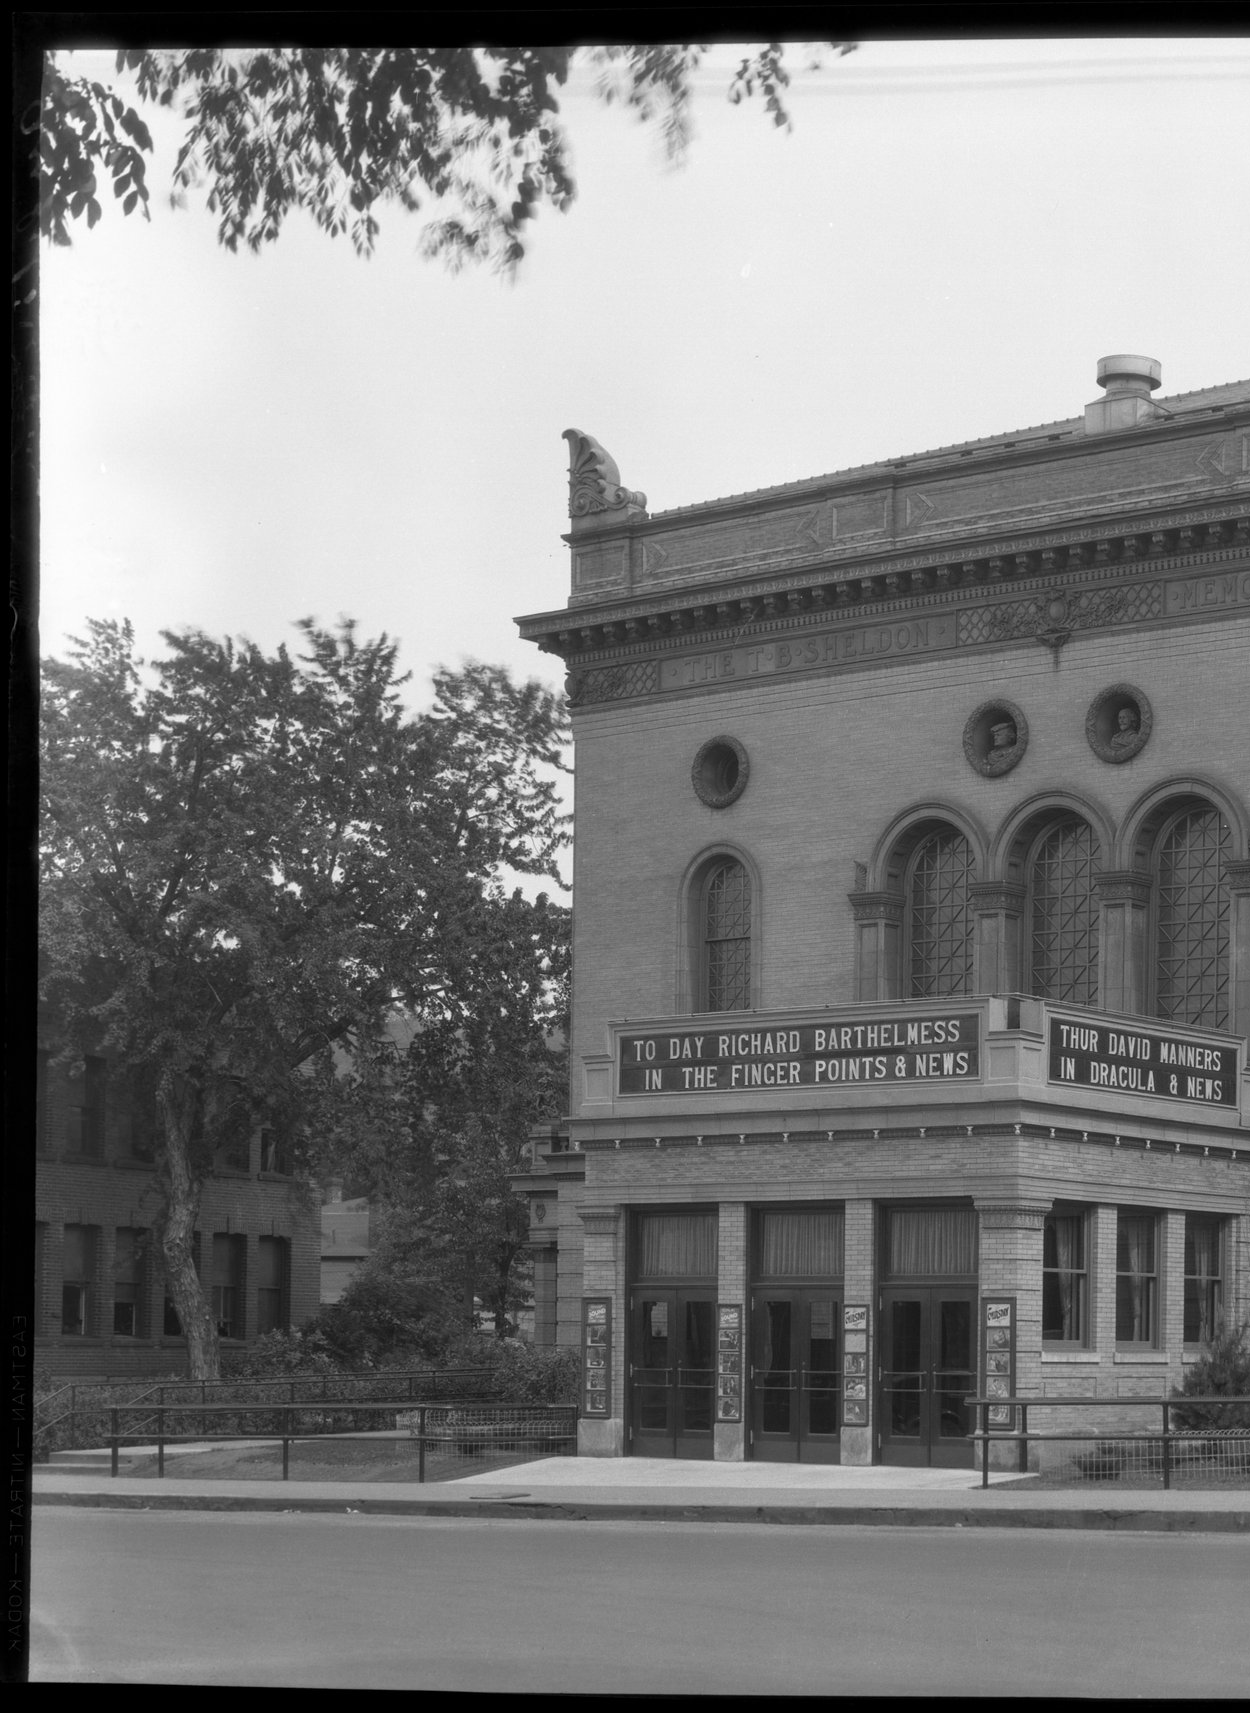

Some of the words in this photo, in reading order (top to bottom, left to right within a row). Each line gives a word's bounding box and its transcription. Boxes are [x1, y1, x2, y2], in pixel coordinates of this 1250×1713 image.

[684, 652, 736, 683] THE
[803, 620, 931, 665] SHELDON
[633, 1040, 656, 1062] TO
[669, 1036, 704, 1060] DAY
[718, 1030, 800, 1057] RICHARD
[815, 1020, 960, 1051] BARTHELMESS
[1060, 1024, 1098, 1053] THUR
[1109, 1032, 1151, 1060] DAVID
[1159, 1042, 1221, 1072] MANNERS
[645, 1068, 662, 1090] IN
[682, 1066, 718, 1089] THE
[731, 1061, 801, 1087] FINGER
[814, 1056, 887, 1082] POINTS
[895, 1055, 907, 1077] &
[915, 1052, 969, 1077] NEWS
[1060, 1056, 1075, 1081] IN
[1090, 1061, 1156, 1092] DRACULA
[1169, 1074, 1178, 1095] &
[1187, 1076, 1222, 1101] NEWS
